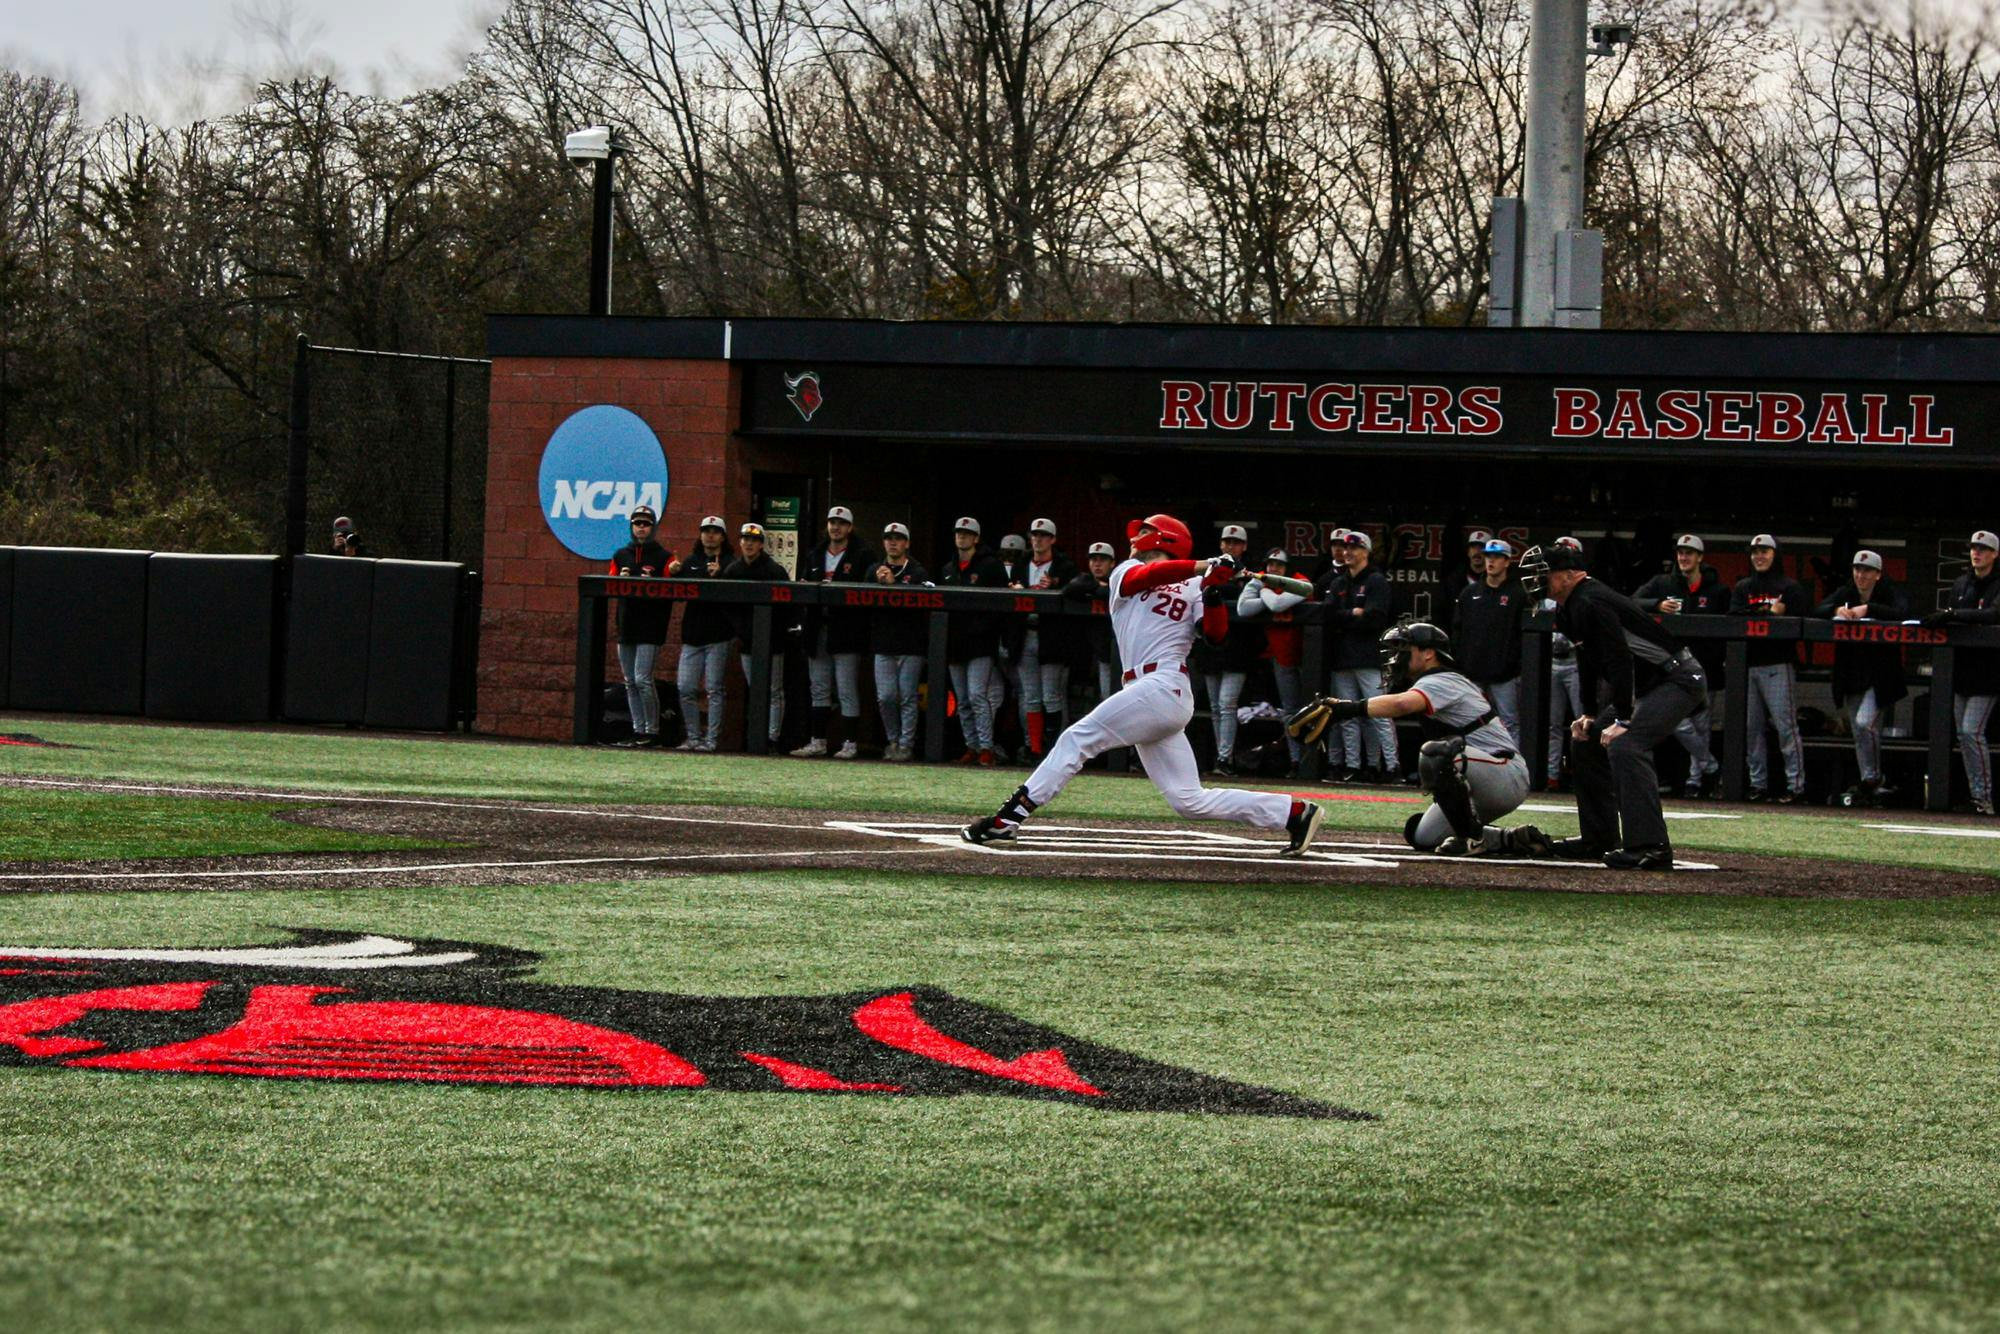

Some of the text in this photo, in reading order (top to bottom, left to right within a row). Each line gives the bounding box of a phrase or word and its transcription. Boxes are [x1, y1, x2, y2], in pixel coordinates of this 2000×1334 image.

[1160, 381, 1953, 446] RUTGERS BASEBALL
[550, 480, 663, 521] NCAA
[1385, 568, 1441, 583] SEBAL
[605, 581, 700, 599] RUTGERS
[845, 589, 945, 608] RUTGERS
[1151, 593, 1187, 621] 28
[1832, 623, 1948, 643] RUTGERS
